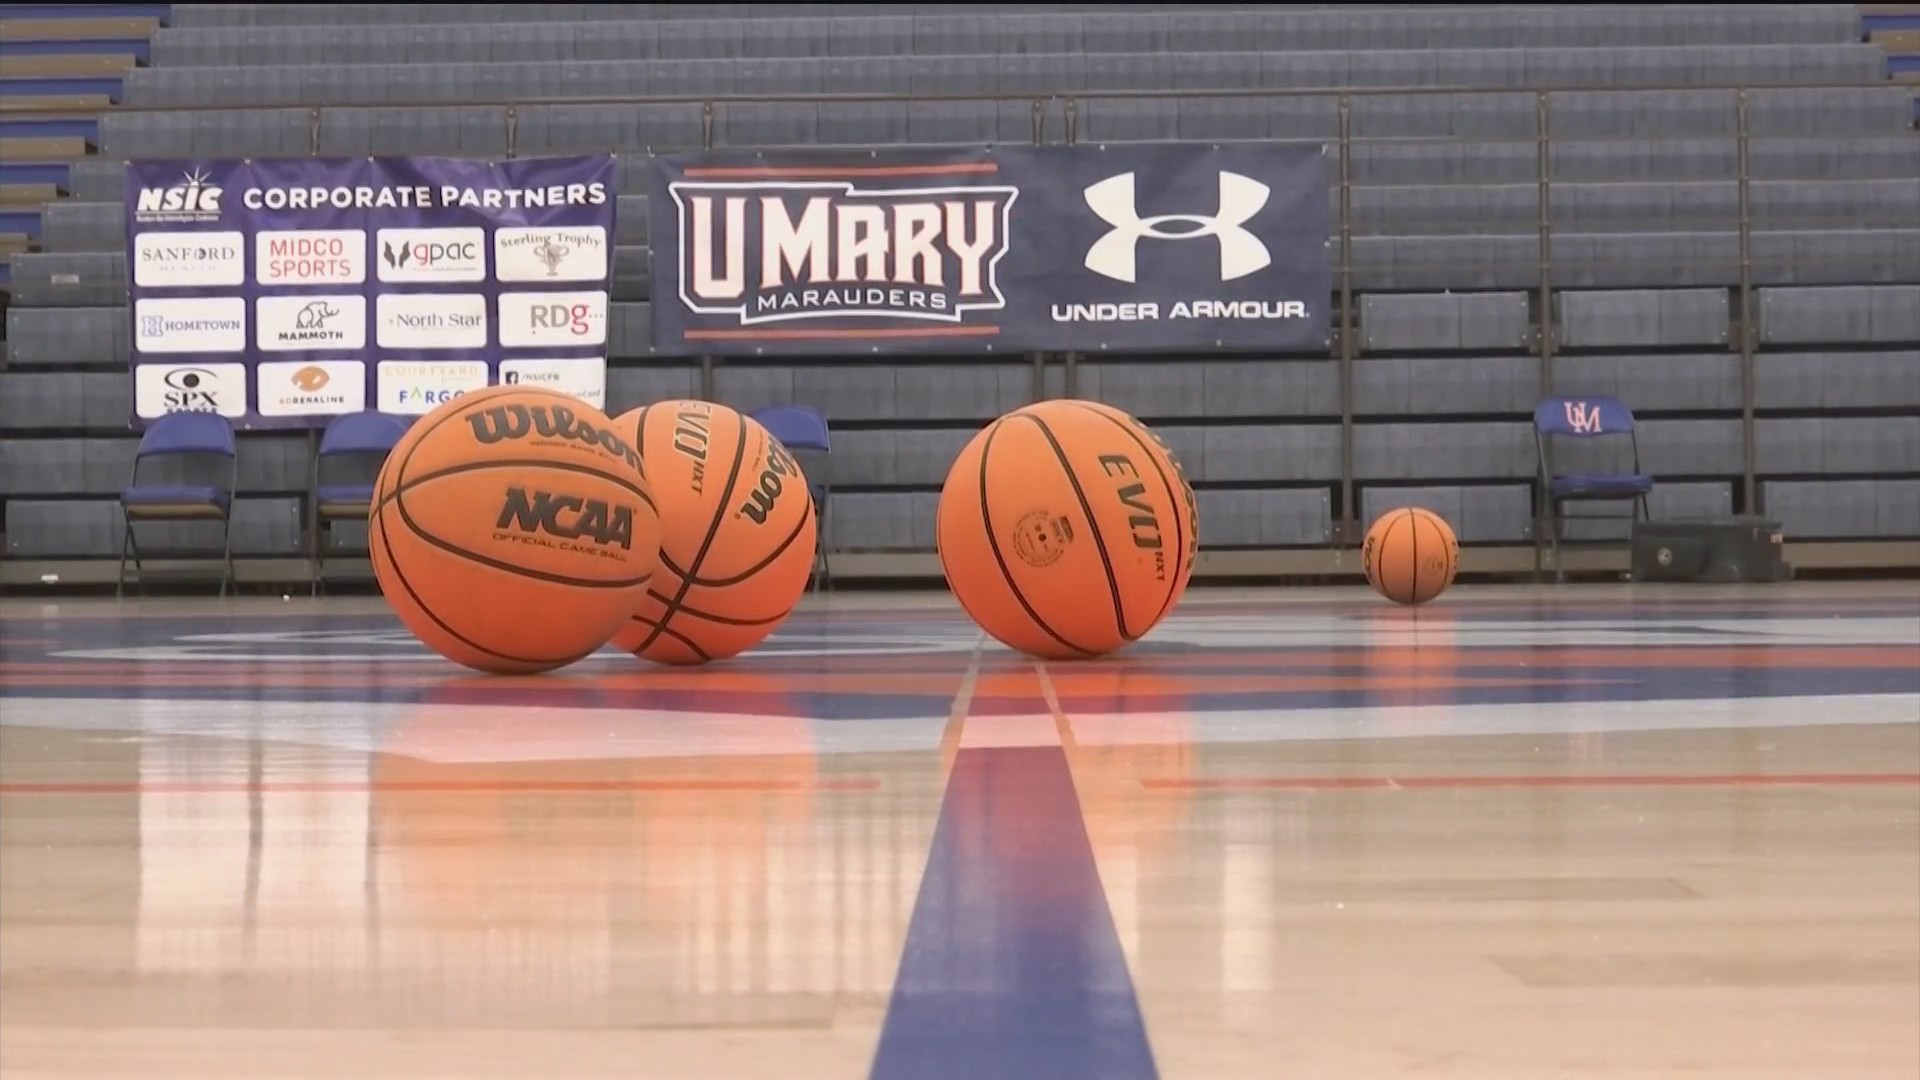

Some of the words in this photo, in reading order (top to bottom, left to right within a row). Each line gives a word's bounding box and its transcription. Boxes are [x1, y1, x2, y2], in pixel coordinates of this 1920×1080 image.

[137, 184, 223, 211] NSIC
[243, 186, 433, 209] CORPORATE
[440, 183, 607, 209] PARTNERS
[269, 238, 344, 257] MIDCO
[500, 233, 552, 248] Sterling
[556, 232, 602, 248] Trophy
[142, 246, 235, 261] SANFORD
[413, 242, 476, 266] gpac
[269, 259, 351, 278] SPORTS
[757, 289, 947, 312] MARAUDERS
[1051, 303, 1160, 322] UNDER
[1169, 300, 1306, 319] ARMOUR
[165, 319, 240, 331] HOMETOWN
[396, 312, 443, 327] North
[447, 313, 482, 327] Star
[278, 331, 343, 341] MAMMOTH
[164, 391, 218, 407] SPX
[278, 395, 345, 405] ADRENALINE
[1562, 401, 1602, 434] UM
[464, 403, 646, 481] Wilson
[691, 460, 706, 498] NXT
[495, 485, 632, 550] NCAA
[1097, 453, 1163, 549] EVO
[1153, 550, 1167, 583] NXT
[492, 532, 556, 550] OFFICIAL
[599, 550, 628, 563] BALL
